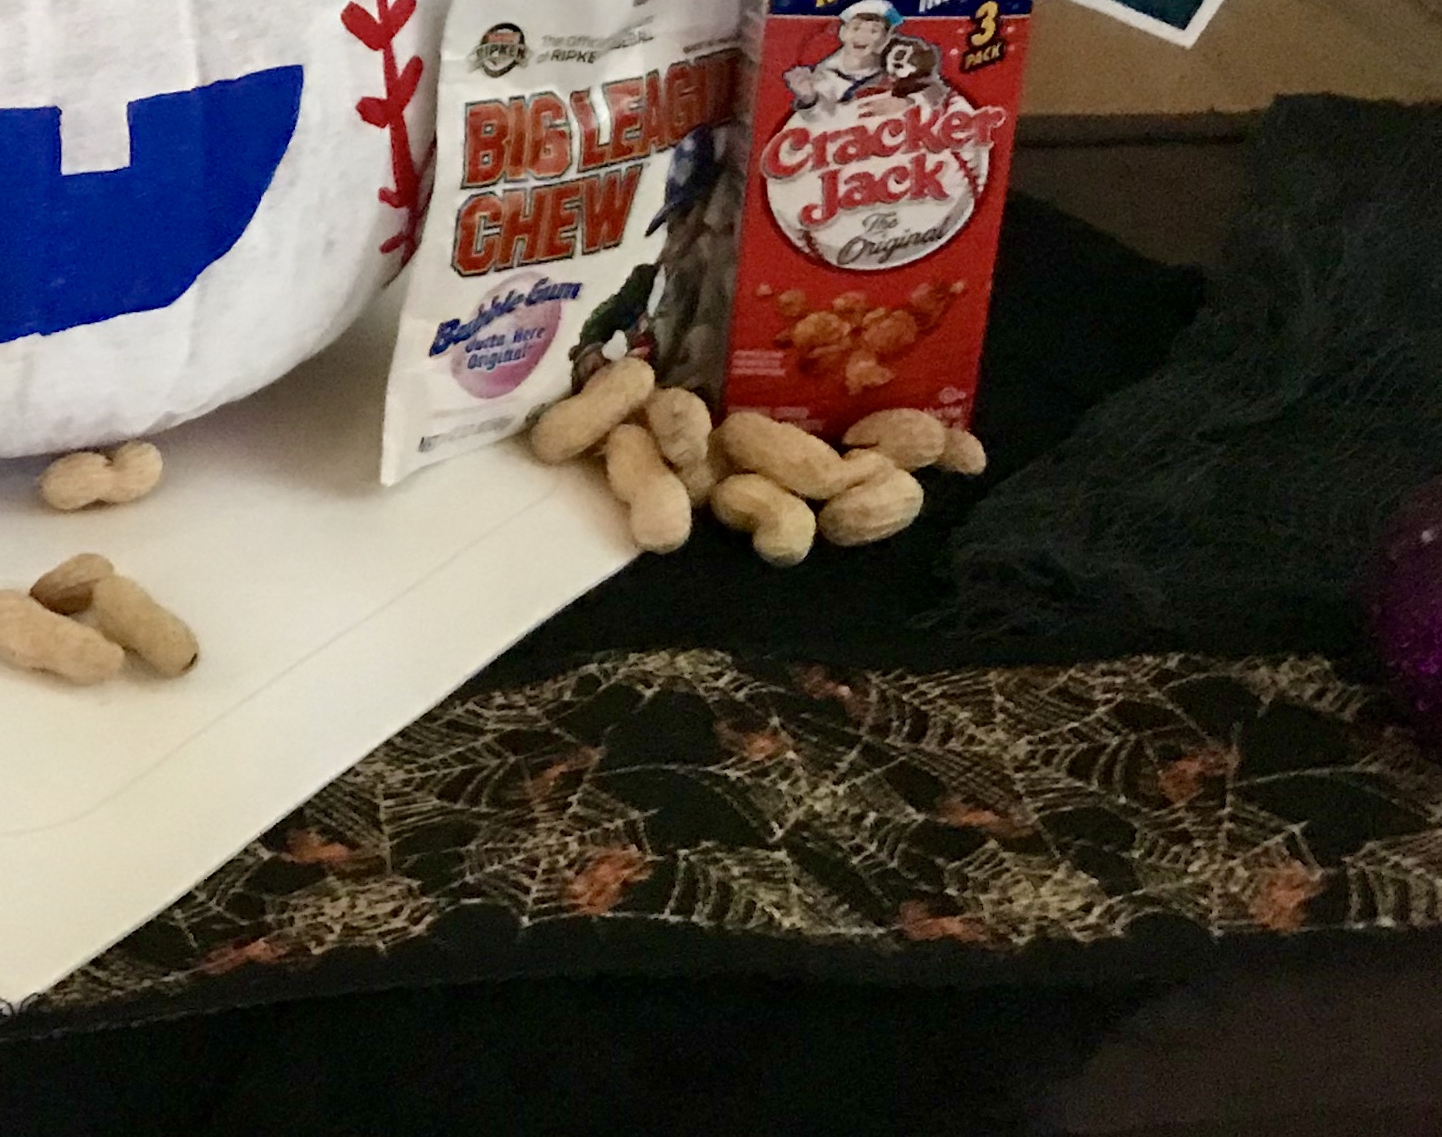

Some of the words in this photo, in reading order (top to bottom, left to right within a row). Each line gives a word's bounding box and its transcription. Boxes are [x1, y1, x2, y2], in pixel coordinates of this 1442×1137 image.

[971, 0, 999, 47] 3
[550, 49, 598, 64] RIPKE
[964, 42, 1003, 70] PACK
[461, 91, 573, 190] BIG
[570, 47, 742, 173] LEAG
[761, 105, 1007, 180] Cracker
[798, 153, 950, 226] Jack
[451, 163, 644, 277] CHEW
[837, 214, 954, 266] Original
[862, 210, 900, 236] The
[524, 276, 583, 307] Gum
[467, 342, 528, 371] Original
